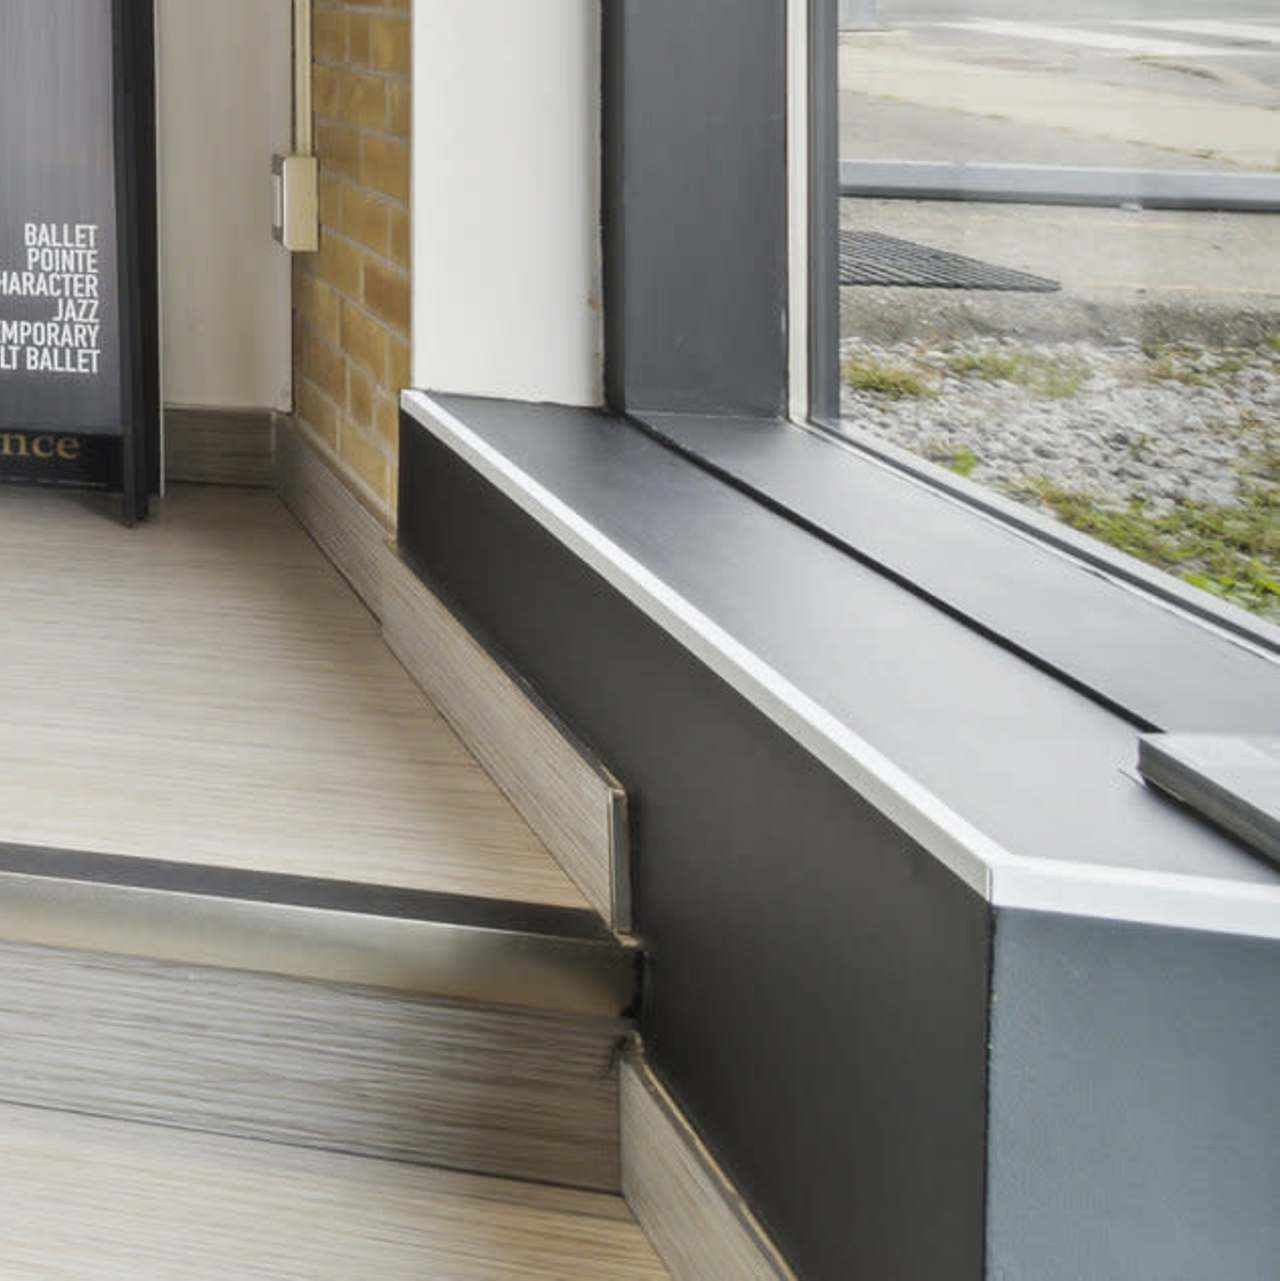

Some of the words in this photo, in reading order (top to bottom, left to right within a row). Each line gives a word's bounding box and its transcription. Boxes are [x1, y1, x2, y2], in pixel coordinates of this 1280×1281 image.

[24, 223, 99, 249] BALLET
[27, 247, 99, 273] POINTE
[52, 298, 100, 323] JAZZ
[25, 345, 101, 374] BALLET
